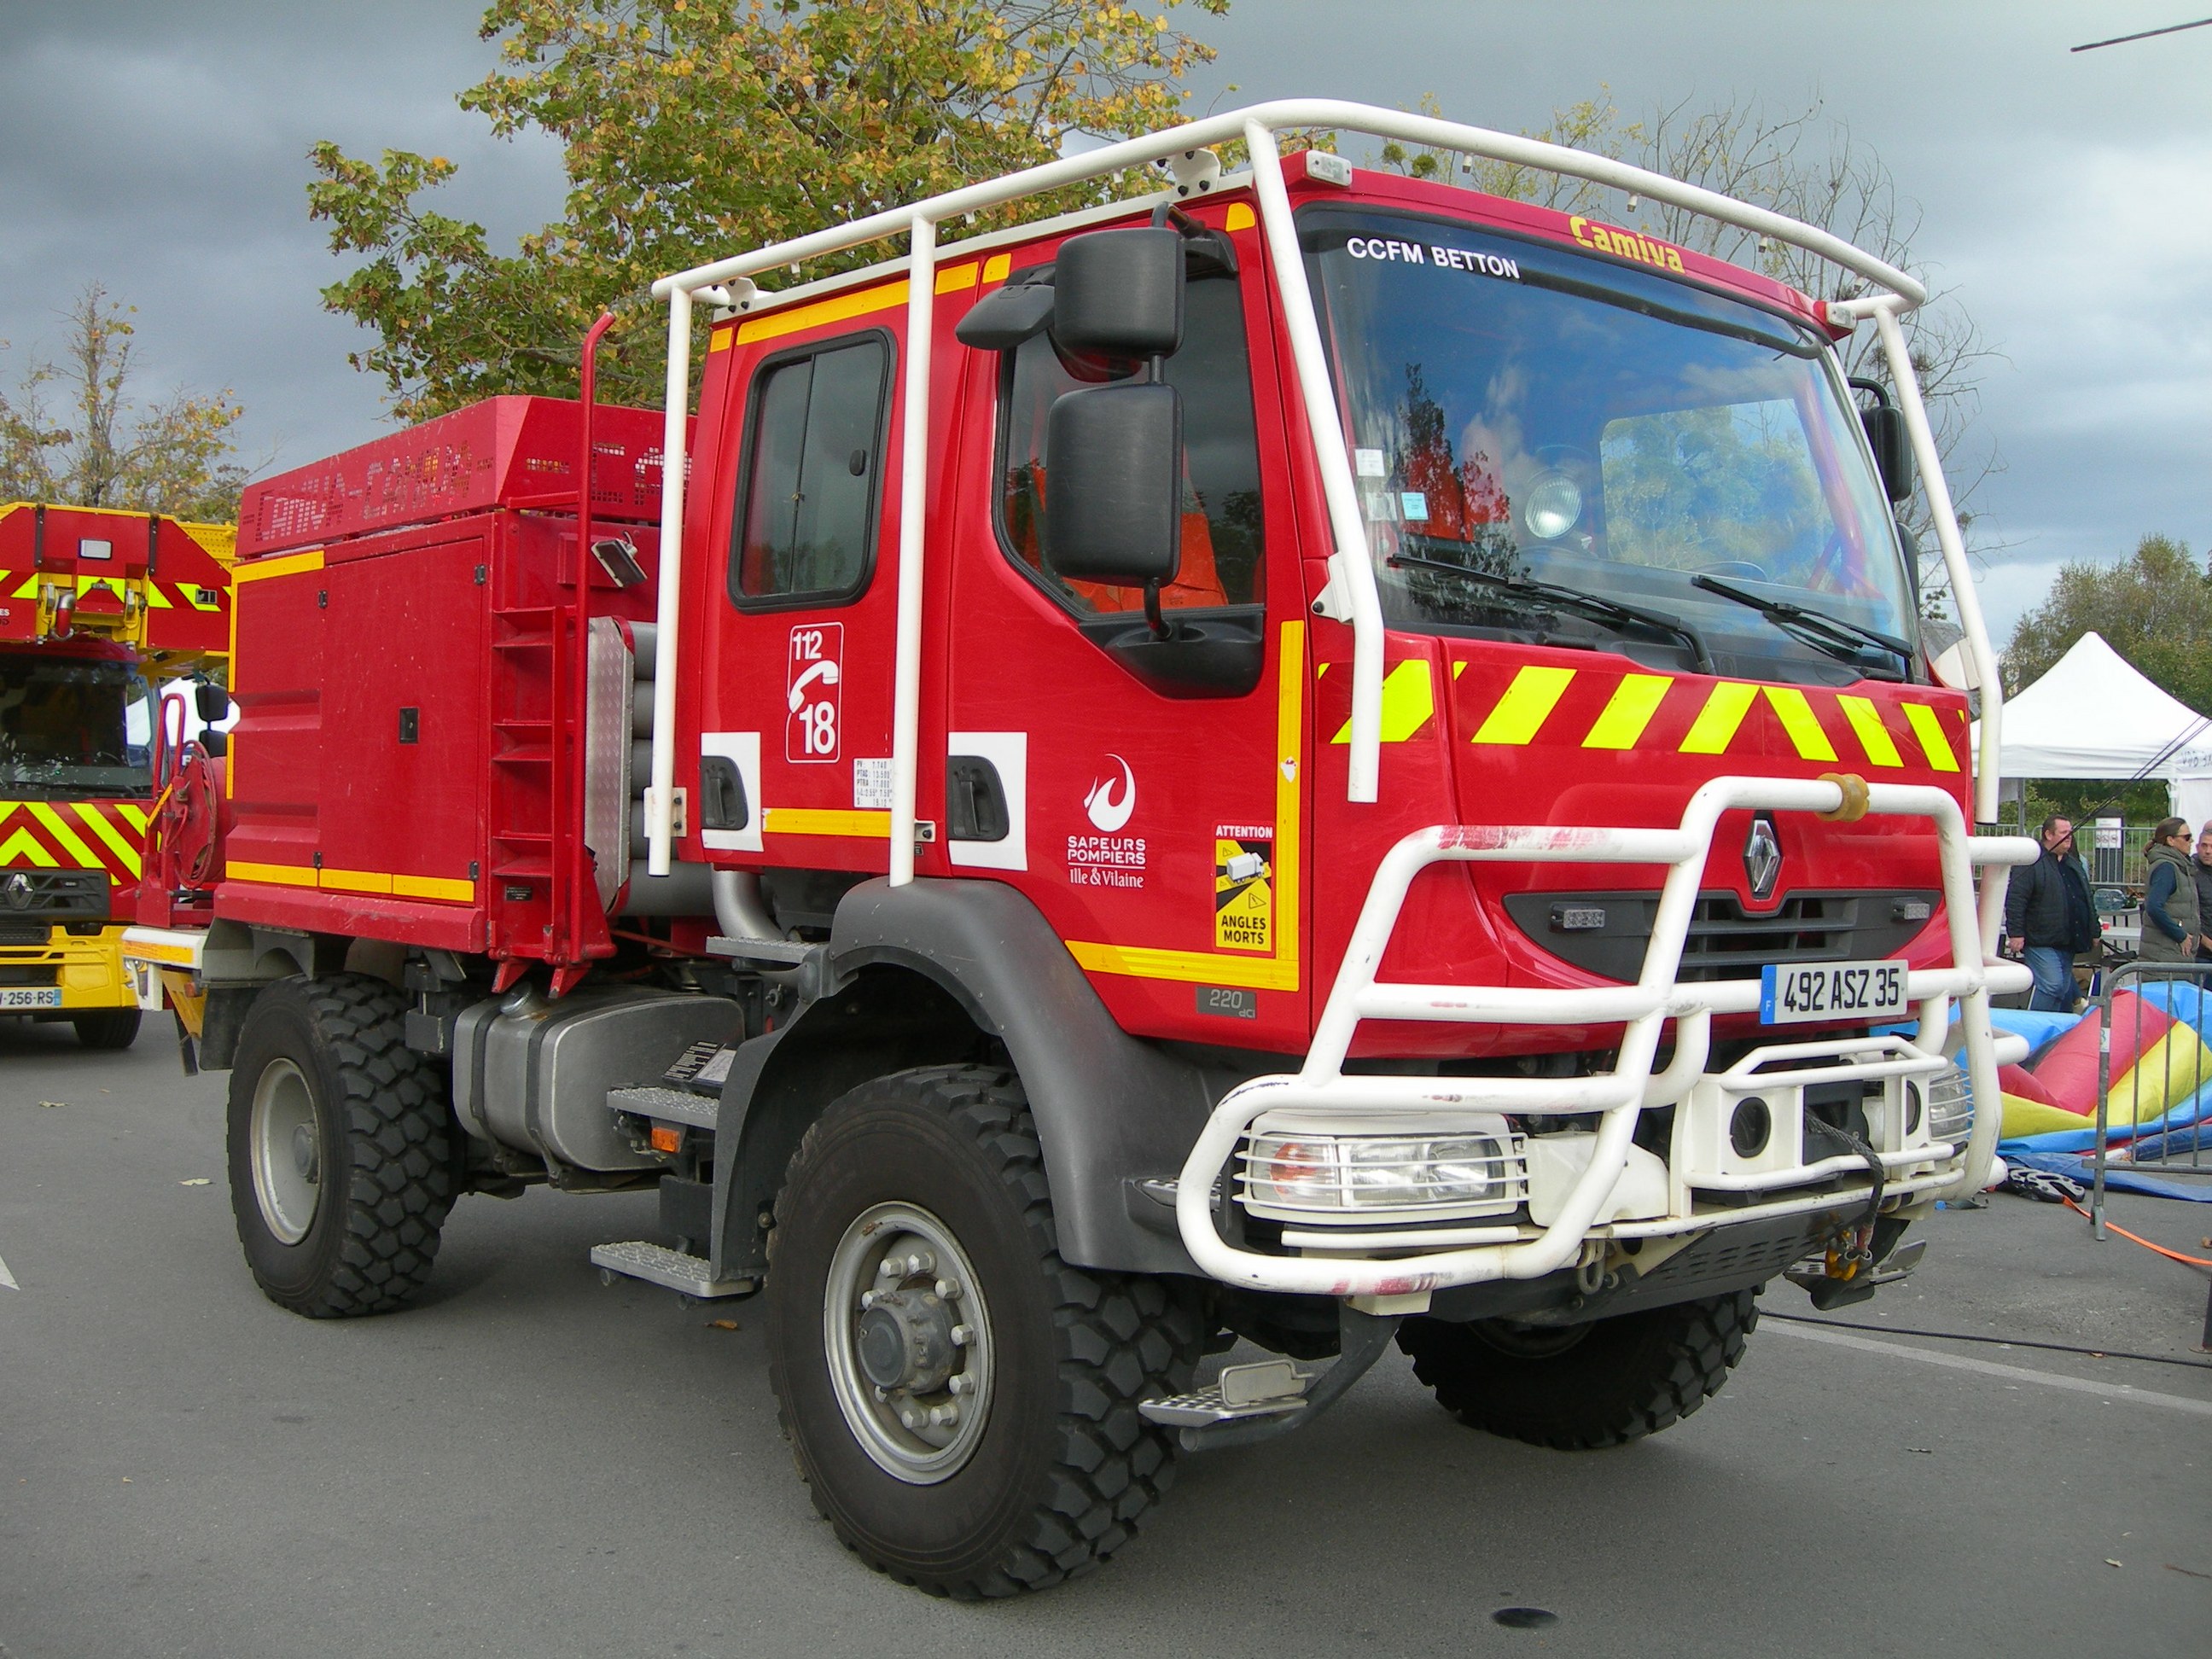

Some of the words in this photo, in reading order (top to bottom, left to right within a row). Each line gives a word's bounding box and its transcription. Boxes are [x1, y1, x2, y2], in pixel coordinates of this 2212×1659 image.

[1569, 215, 1686, 274] Camiva
[1346, 236, 1424, 265] CCFM
[1430, 245, 1521, 280] BETTON
[793, 630, 823, 661] 112
[798, 701, 835, 754] 18
[1214, 824, 1272, 839] ATTENTION
[1068, 835, 1146, 852] SAPEURS
[1068, 848, 1146, 864] POMPIERS
[1069, 867, 1088, 884] Ille
[1090, 867, 1101, 886] &
[1102, 870, 1144, 888] Vilaine
[1221, 915, 1266, 930] ANGLES
[1223, 929, 1265, 945] MORTS
[1208, 989, 1243, 1010] 220
[1765, 1000, 1771, 1012] F
[1784, 971, 1825, 1012] 492
[1831, 969, 1870, 1010] ASZ
[1875, 968, 1900, 1007] 35
